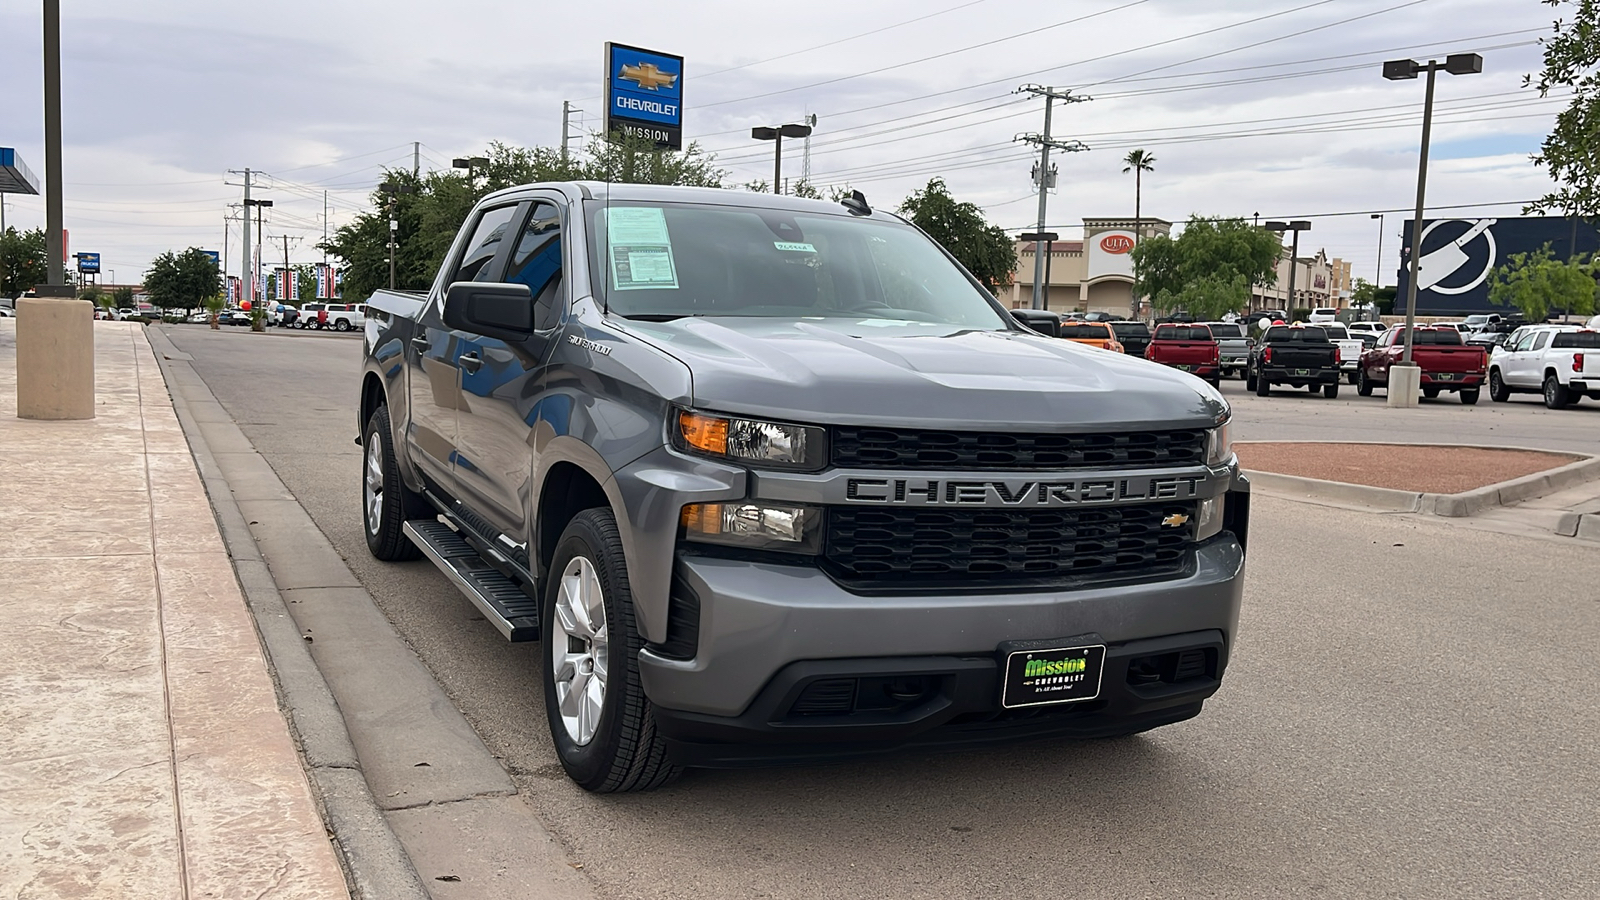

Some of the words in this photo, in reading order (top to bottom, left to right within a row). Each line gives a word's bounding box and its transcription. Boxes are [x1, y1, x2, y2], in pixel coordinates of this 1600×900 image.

[617, 96, 677, 116] CHEVROLET
[624, 126, 669, 142] MISSION
[1106, 238, 1130, 248] ULTA
[845, 475, 1206, 504] CHEVROLET
[1024, 657, 1086, 677] Mission
[1035, 674, 1085, 685] CHEVROLET
